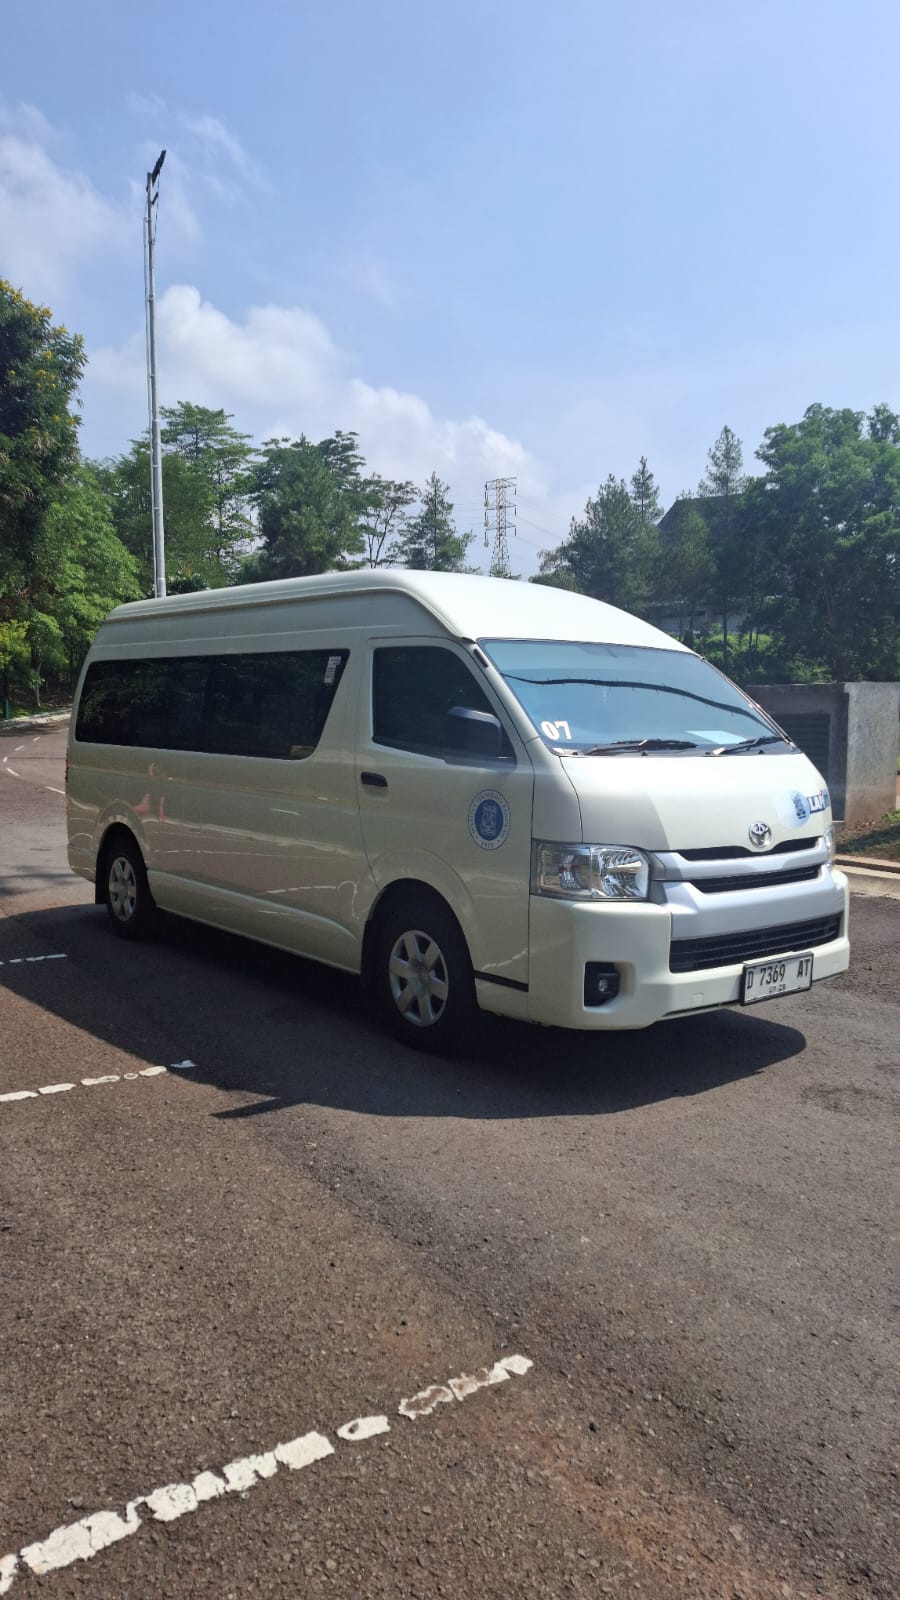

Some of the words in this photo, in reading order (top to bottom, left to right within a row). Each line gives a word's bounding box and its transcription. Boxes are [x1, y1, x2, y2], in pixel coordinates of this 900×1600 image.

[541, 720, 572, 740] 07
[747, 970, 754, 989] D
[760, 963, 786, 986] 7369
[797, 958, 811, 978] AT
